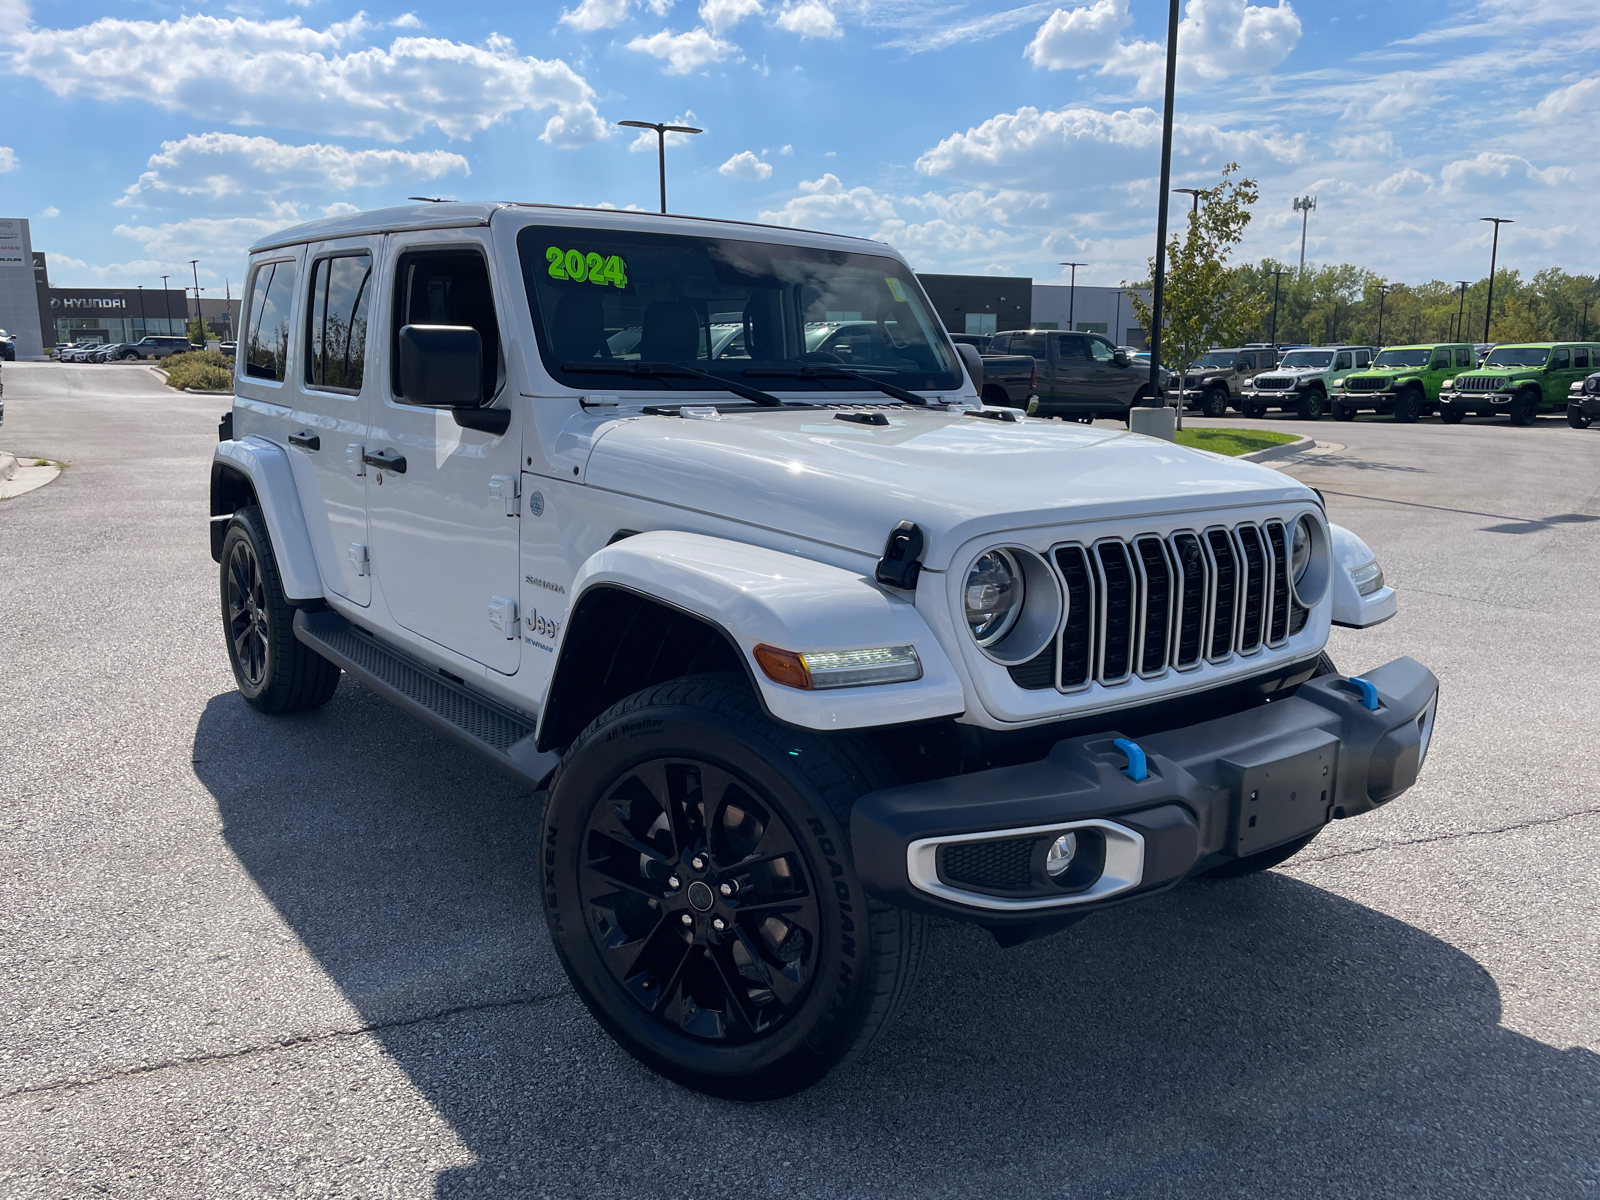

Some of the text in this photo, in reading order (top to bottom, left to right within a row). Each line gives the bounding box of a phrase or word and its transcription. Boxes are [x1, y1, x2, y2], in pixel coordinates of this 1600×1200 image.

[545, 246, 628, 289] 2024
[63, 298, 126, 309] HYUNDAI
[525, 574, 566, 595] SAHARA
[606, 717, 664, 743] All-Weather
[545, 824, 565, 932] NEXEN
[806, 817, 856, 959] ROADIAN
